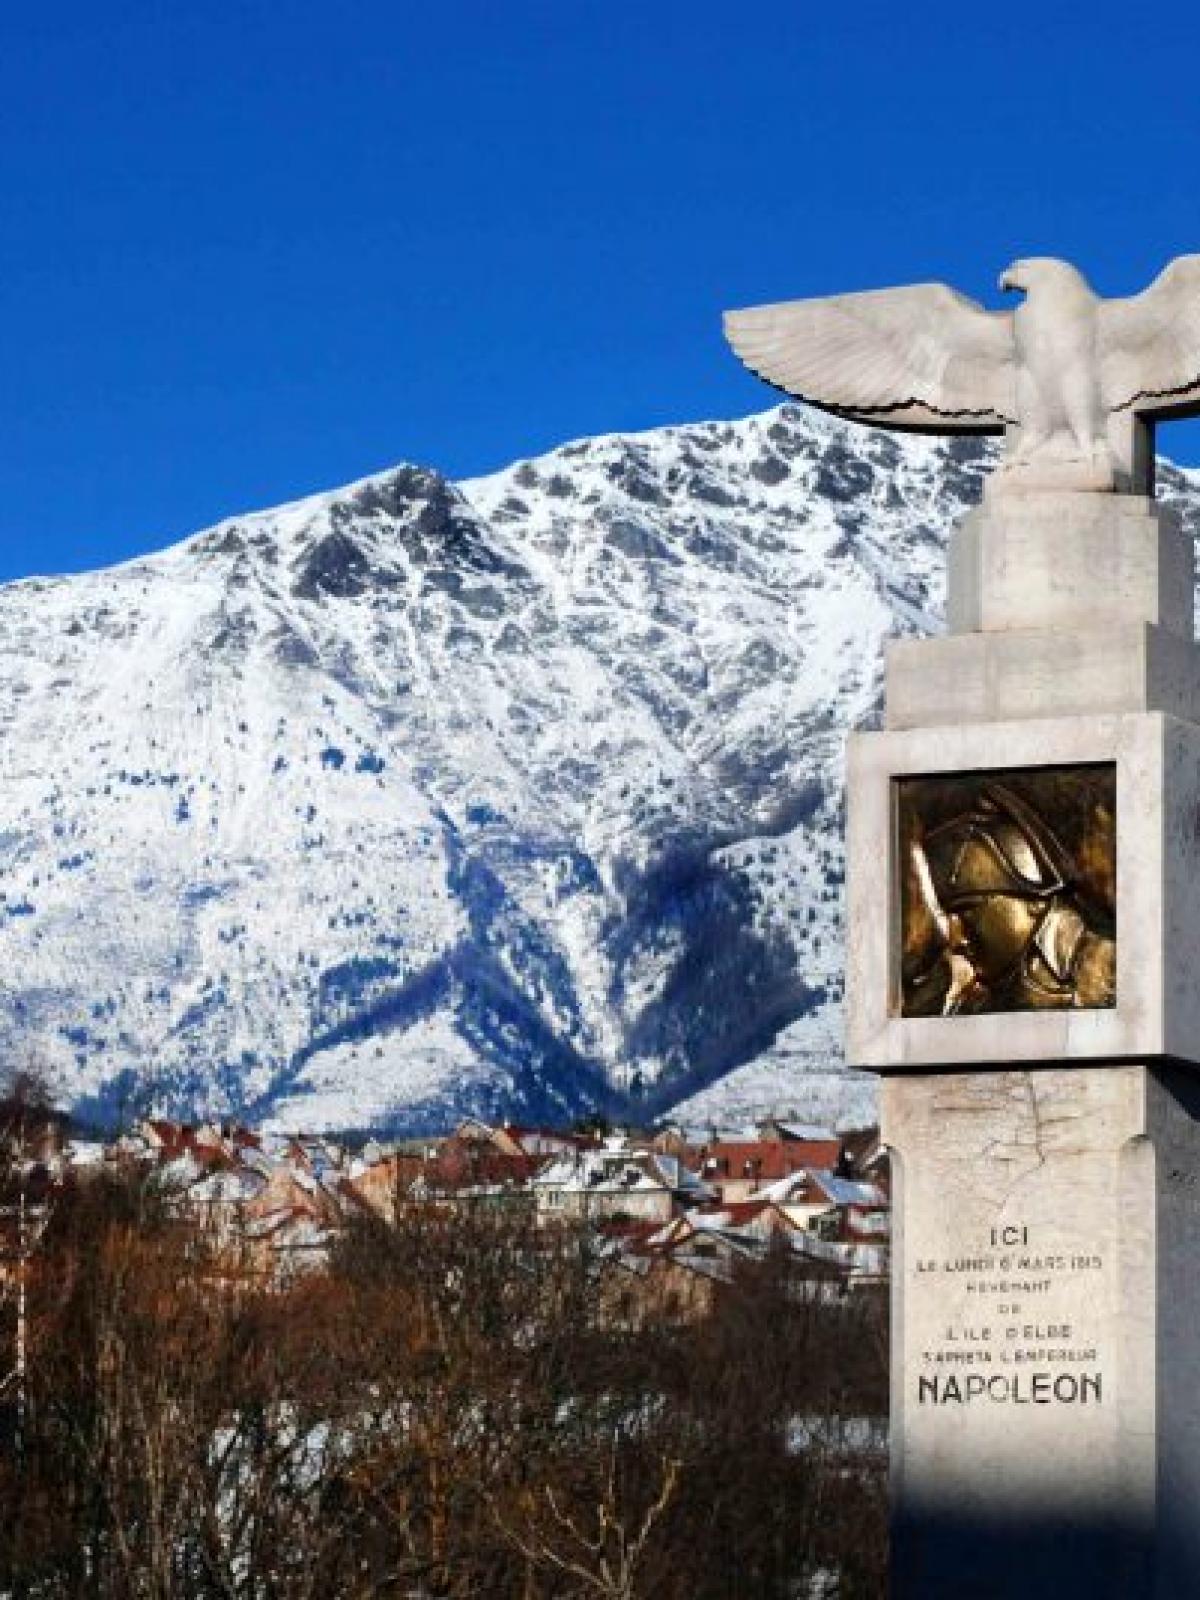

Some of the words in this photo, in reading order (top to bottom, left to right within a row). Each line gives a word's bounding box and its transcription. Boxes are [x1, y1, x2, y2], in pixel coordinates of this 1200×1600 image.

[990, 1226, 1028, 1246] ICI
[916, 1259, 935, 1272] LE
[1018, 1257, 1066, 1270] MARS
[919, 1373, 1102, 1404] NAPOLEON
